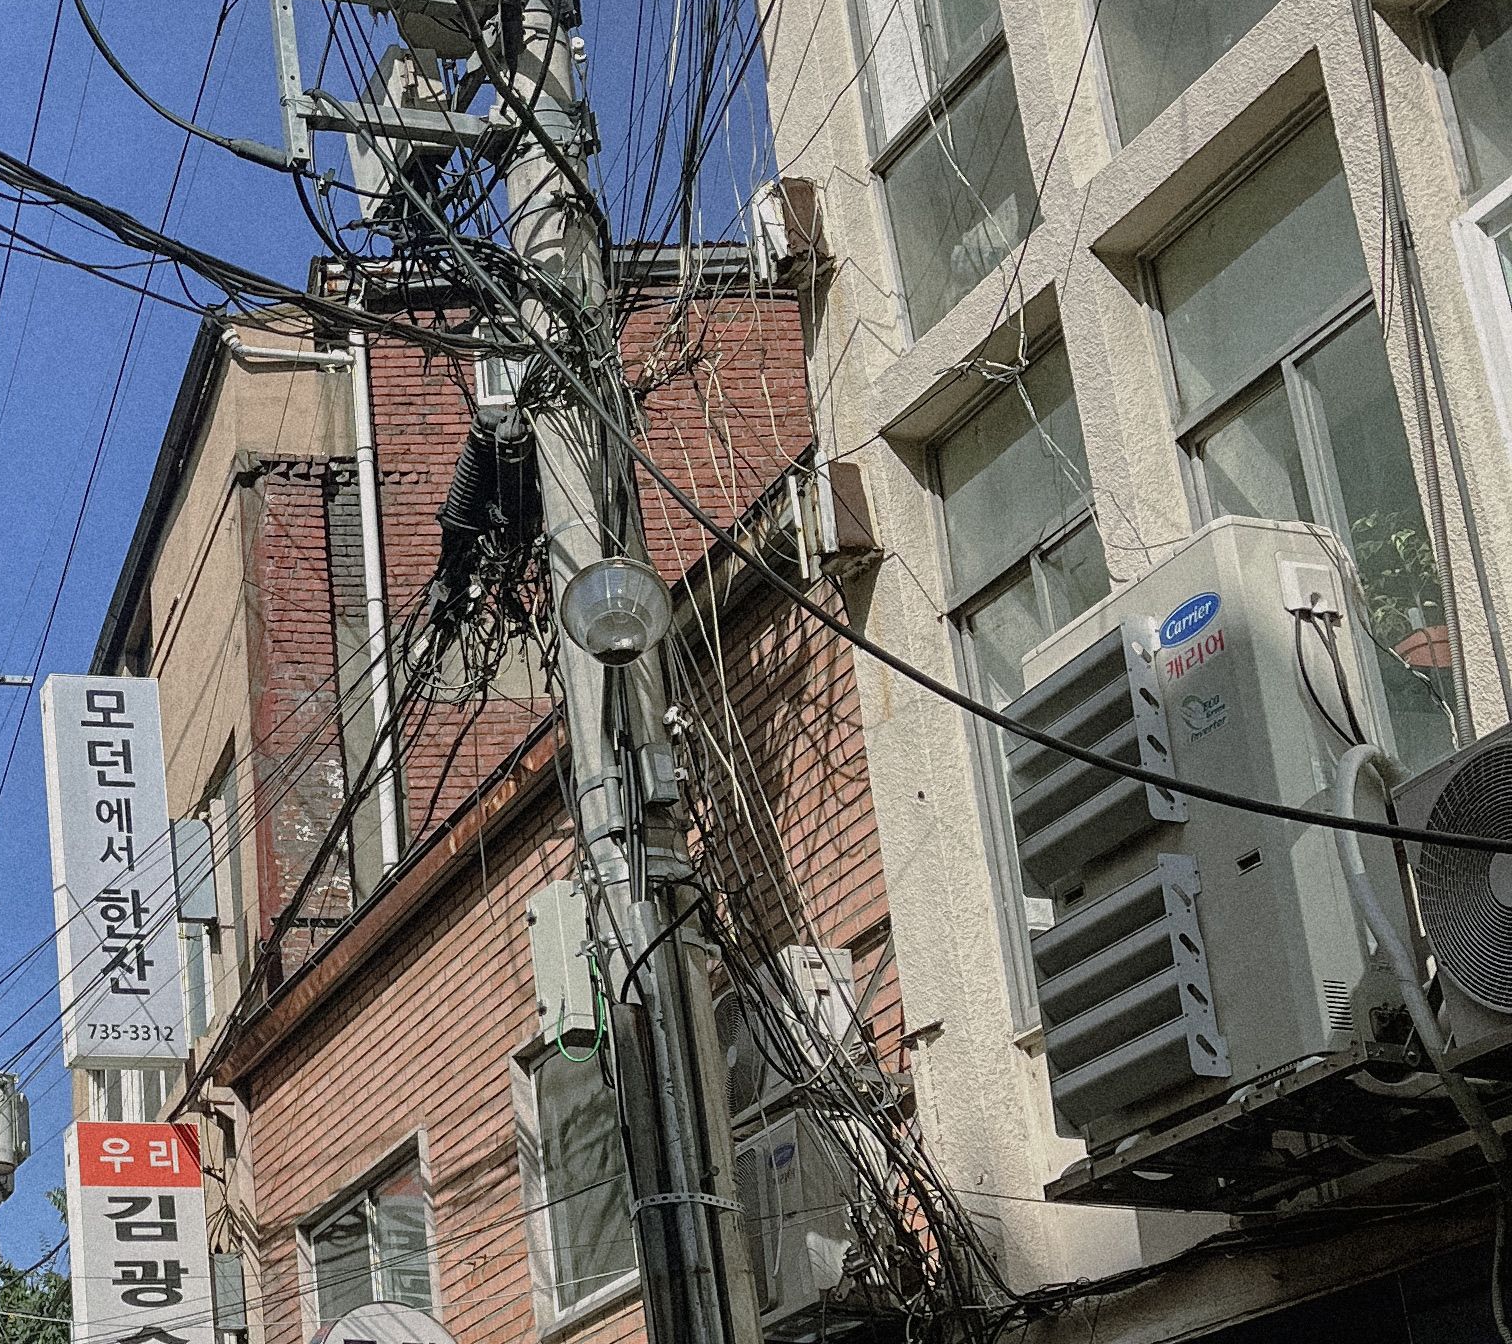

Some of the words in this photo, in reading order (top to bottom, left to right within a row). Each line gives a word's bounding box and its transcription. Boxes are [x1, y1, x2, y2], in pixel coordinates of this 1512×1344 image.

[1165, 599, 1212, 640] Carrier
[1165, 629, 1225, 683] 캐리어
[80, 688, 136, 873] 모던에서
[88, 1023, 175, 1042] 735-3312
[98, 1136, 182, 1175] 우리
